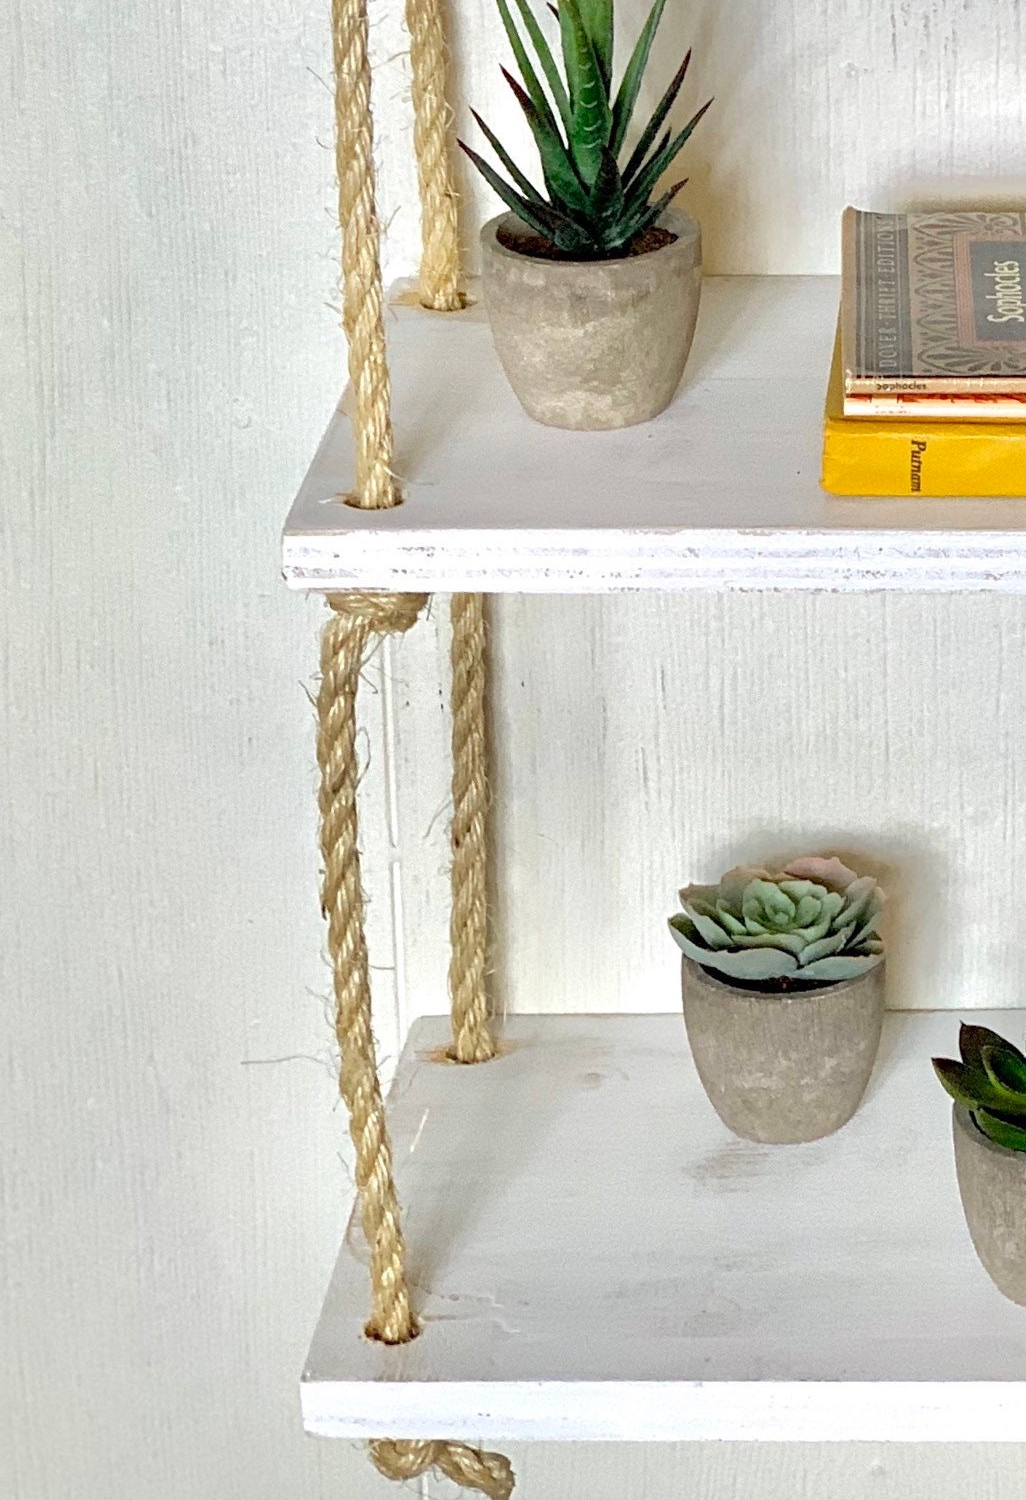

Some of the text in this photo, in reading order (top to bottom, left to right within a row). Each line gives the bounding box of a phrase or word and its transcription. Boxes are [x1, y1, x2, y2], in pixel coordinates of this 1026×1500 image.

[878, 280, 897, 320] THRIFT
[878, 327, 898, 368] DOVER
[911, 439, 927, 492] Putnam
